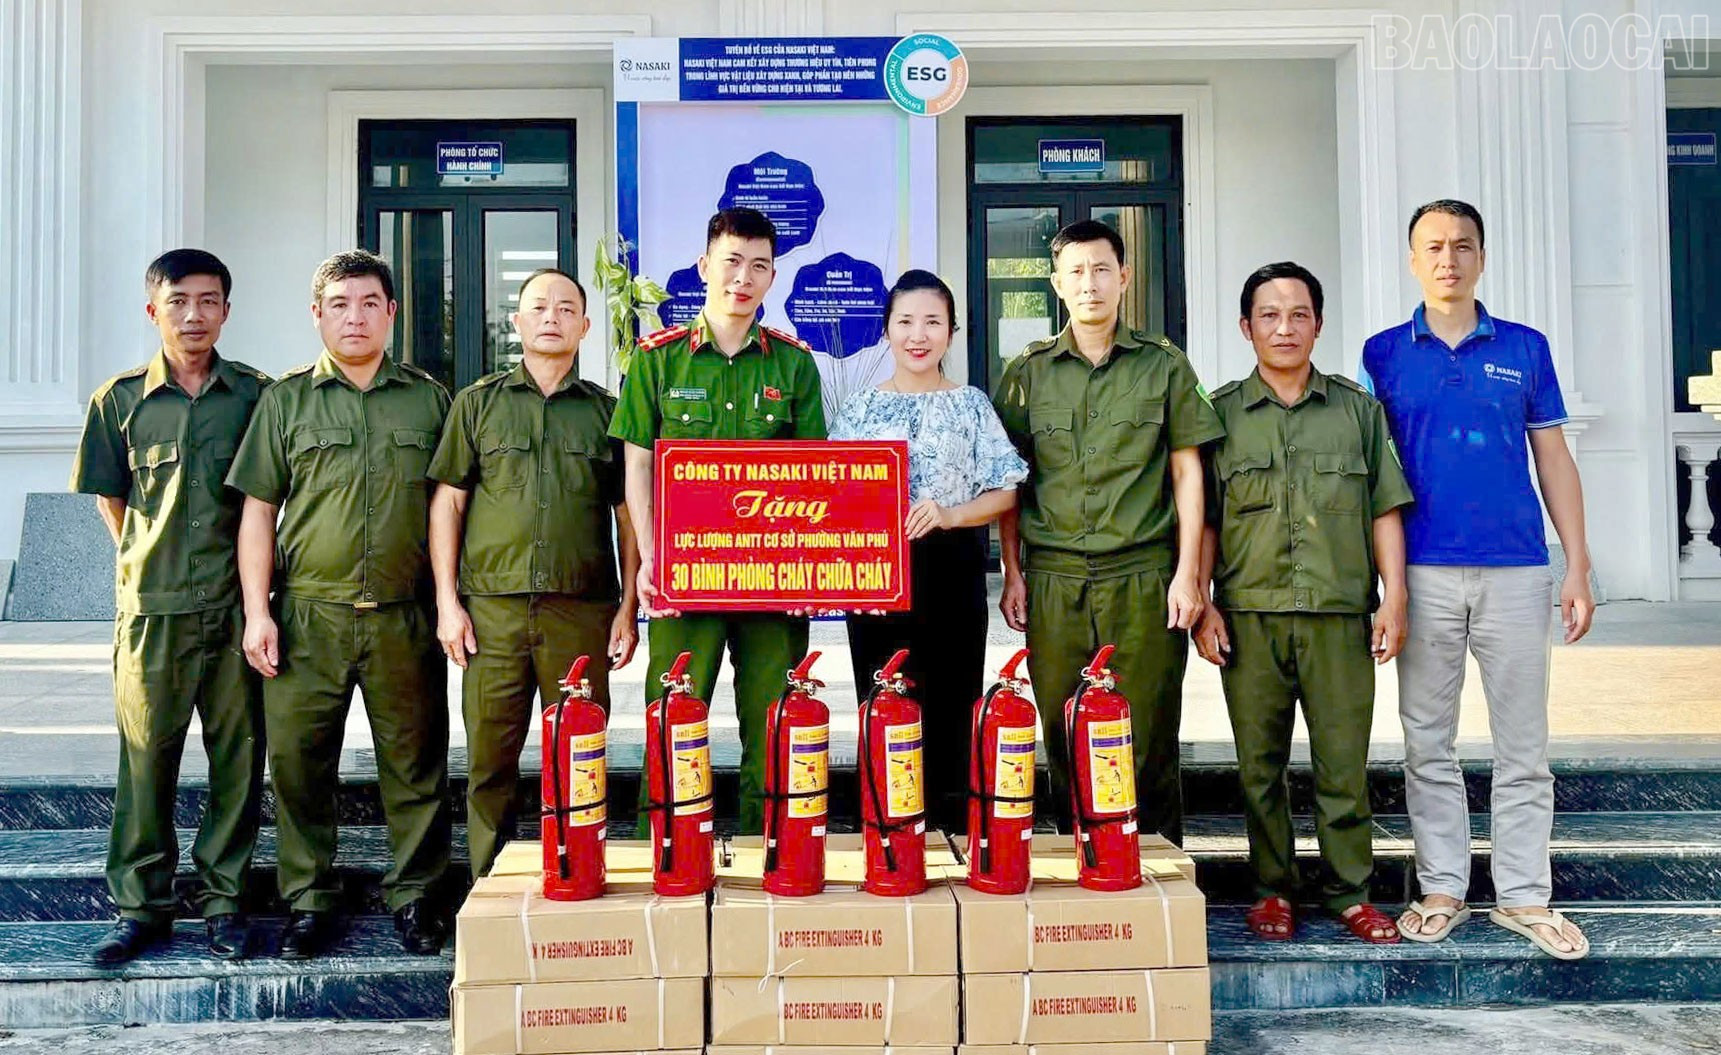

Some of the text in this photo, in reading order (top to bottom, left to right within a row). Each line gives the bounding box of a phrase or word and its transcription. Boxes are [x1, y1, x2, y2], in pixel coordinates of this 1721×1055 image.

[785, 45, 806, 54] NASAKI
[807, 44, 819, 55] VIỆT
[914, 37, 940, 45] SOCIAL
[636, 62, 670, 71] NASAKI
[684, 59, 705, 68] NASAKI
[706, 57, 718, 69] VIỆT
[719, 59, 732, 68] NAM
[907, 67, 947, 81] ESG
[440, 145, 499, 158] PHÒNG TỔ CHỨC
[1042, 145, 1100, 163] PHÒNG KHÁCH
[1676, 145, 1692, 156] KINH
[446, 159, 492, 171] HÀNH CHÍNH
[1496, 366, 1522, 379] NASAKI
[673, 460, 889, 484] CÔNG TY NASAKI VIỆT NAM
[733, 490, 831, 524] Tặng
[674, 528, 889, 551] LỰC LƯỢNG ANTT CƠ SỞ PHƯỜNG VĂN PHÚ
[671, 556, 892, 591] 30 BÌNH PHÒNG CHÁY CHỮA CHÁY
[795, 930, 811, 948] FIRE
[812, 929, 863, 948] EXTINGUISHER
[864, 930, 869, 947] 4
[872, 929, 883, 946] KG
[1046, 924, 1061, 943] FIRE
[1062, 923, 1114, 942] EXTINGUISHER
[1115, 923, 1120, 939] 4
[1122, 922, 1133, 940] KG
[547, 939, 599, 959] EXTINGUISHER
[600, 939, 616, 957] FIRE
[795, 1003, 811, 1020] FIRE
[811, 1002, 863, 1020] EXTINGUISHER
[864, 1002, 869, 1019] 4
[872, 1002, 883, 1020] KG
[1049, 998, 1065, 1015] FIRE
[1066, 996, 1118, 1014] EXTINGUISHER
[1119, 997, 1123, 1013] 4
[1126, 996, 1137, 1013] KG
[538, 1008, 554, 1027] FIRE
[555, 1006, 607, 1026] EXTINGUISHER
[608, 1006, 613, 1023] 4
[616, 1006, 627, 1023] KG
